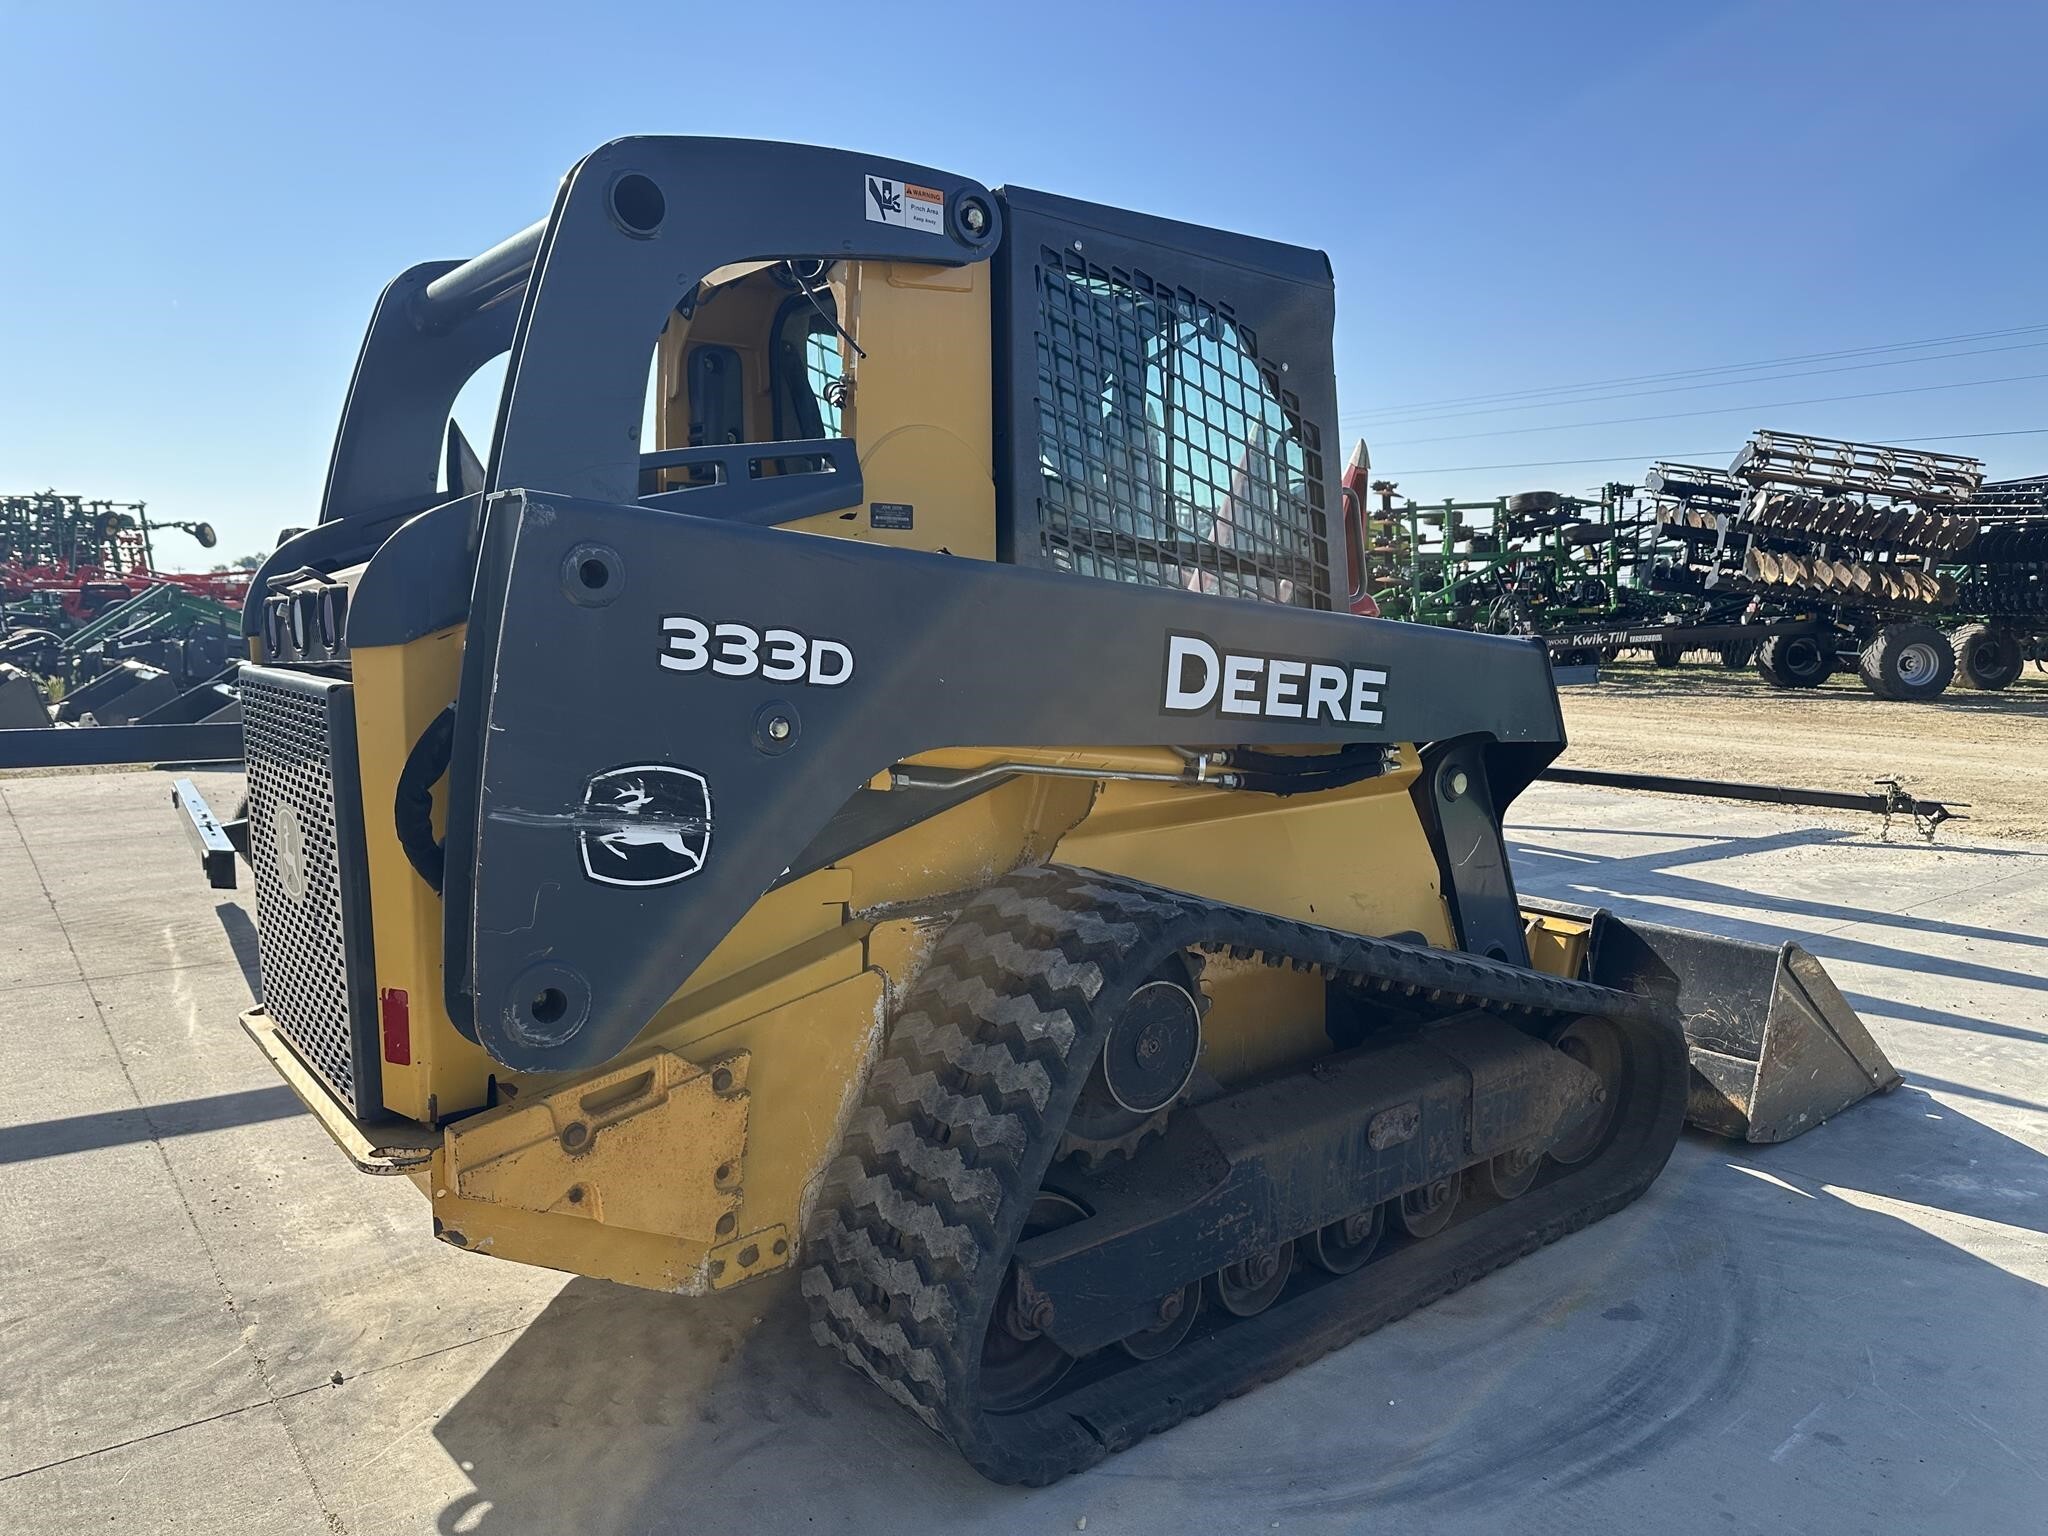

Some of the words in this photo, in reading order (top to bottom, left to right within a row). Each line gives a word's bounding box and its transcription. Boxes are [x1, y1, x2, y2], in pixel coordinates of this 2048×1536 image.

[912, 189, 941, 201] WARNING
[910, 203, 926, 213] Pinch
[926, 207, 939, 215] Area
[1572, 631, 1628, 646] Kwik-Till
[660, 617, 854, 685] 333D
[1165, 635, 1387, 724] DEERE
